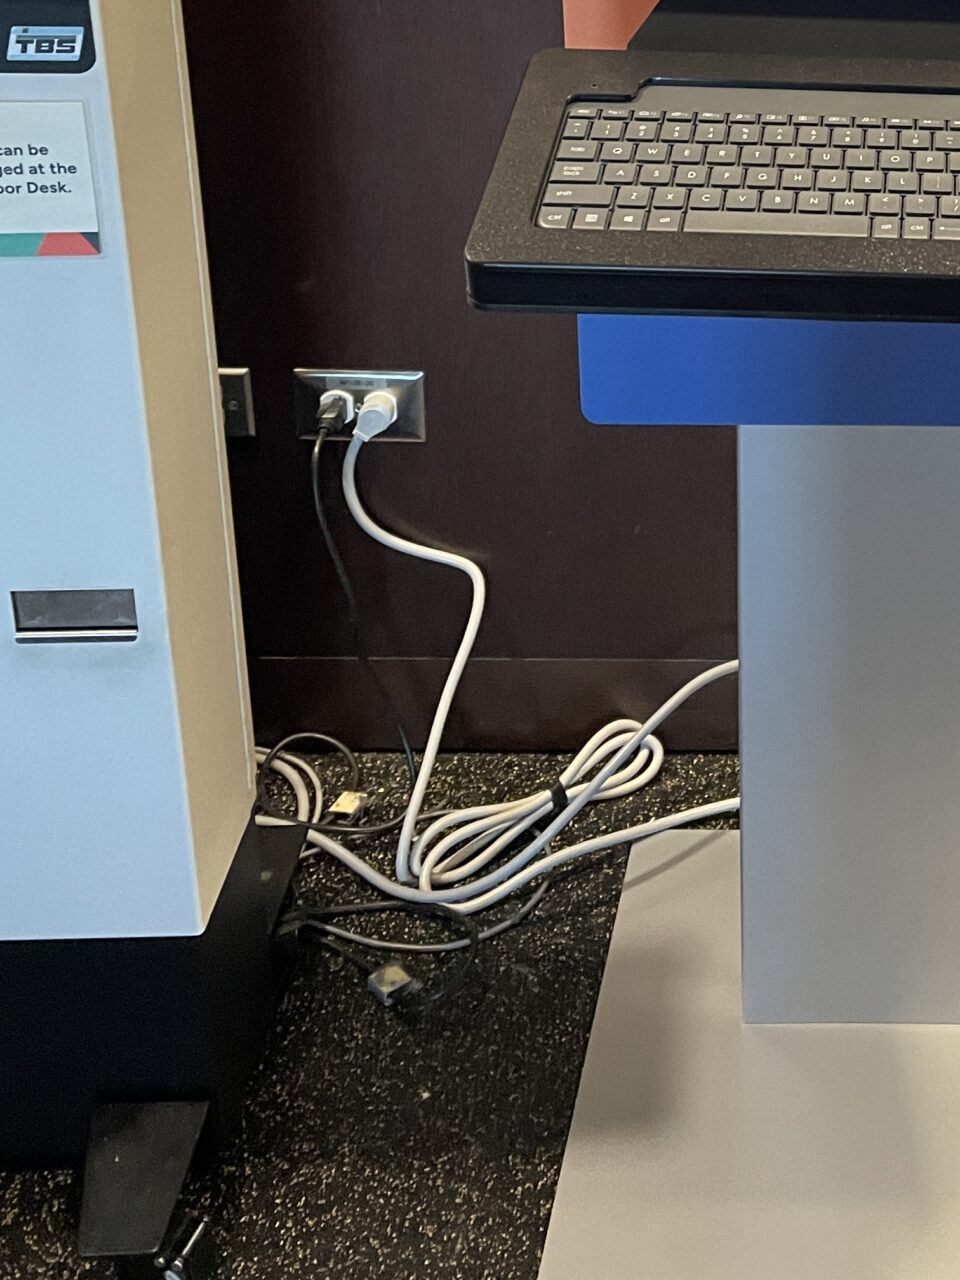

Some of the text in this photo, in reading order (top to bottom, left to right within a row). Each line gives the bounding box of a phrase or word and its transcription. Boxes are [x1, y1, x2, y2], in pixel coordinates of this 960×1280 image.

[15, 35, 76, 53] TBS
[27, 144, 49, 156] be
[0, 162, 77, 178] ed at the
[26, 181, 72, 194] Desk.
